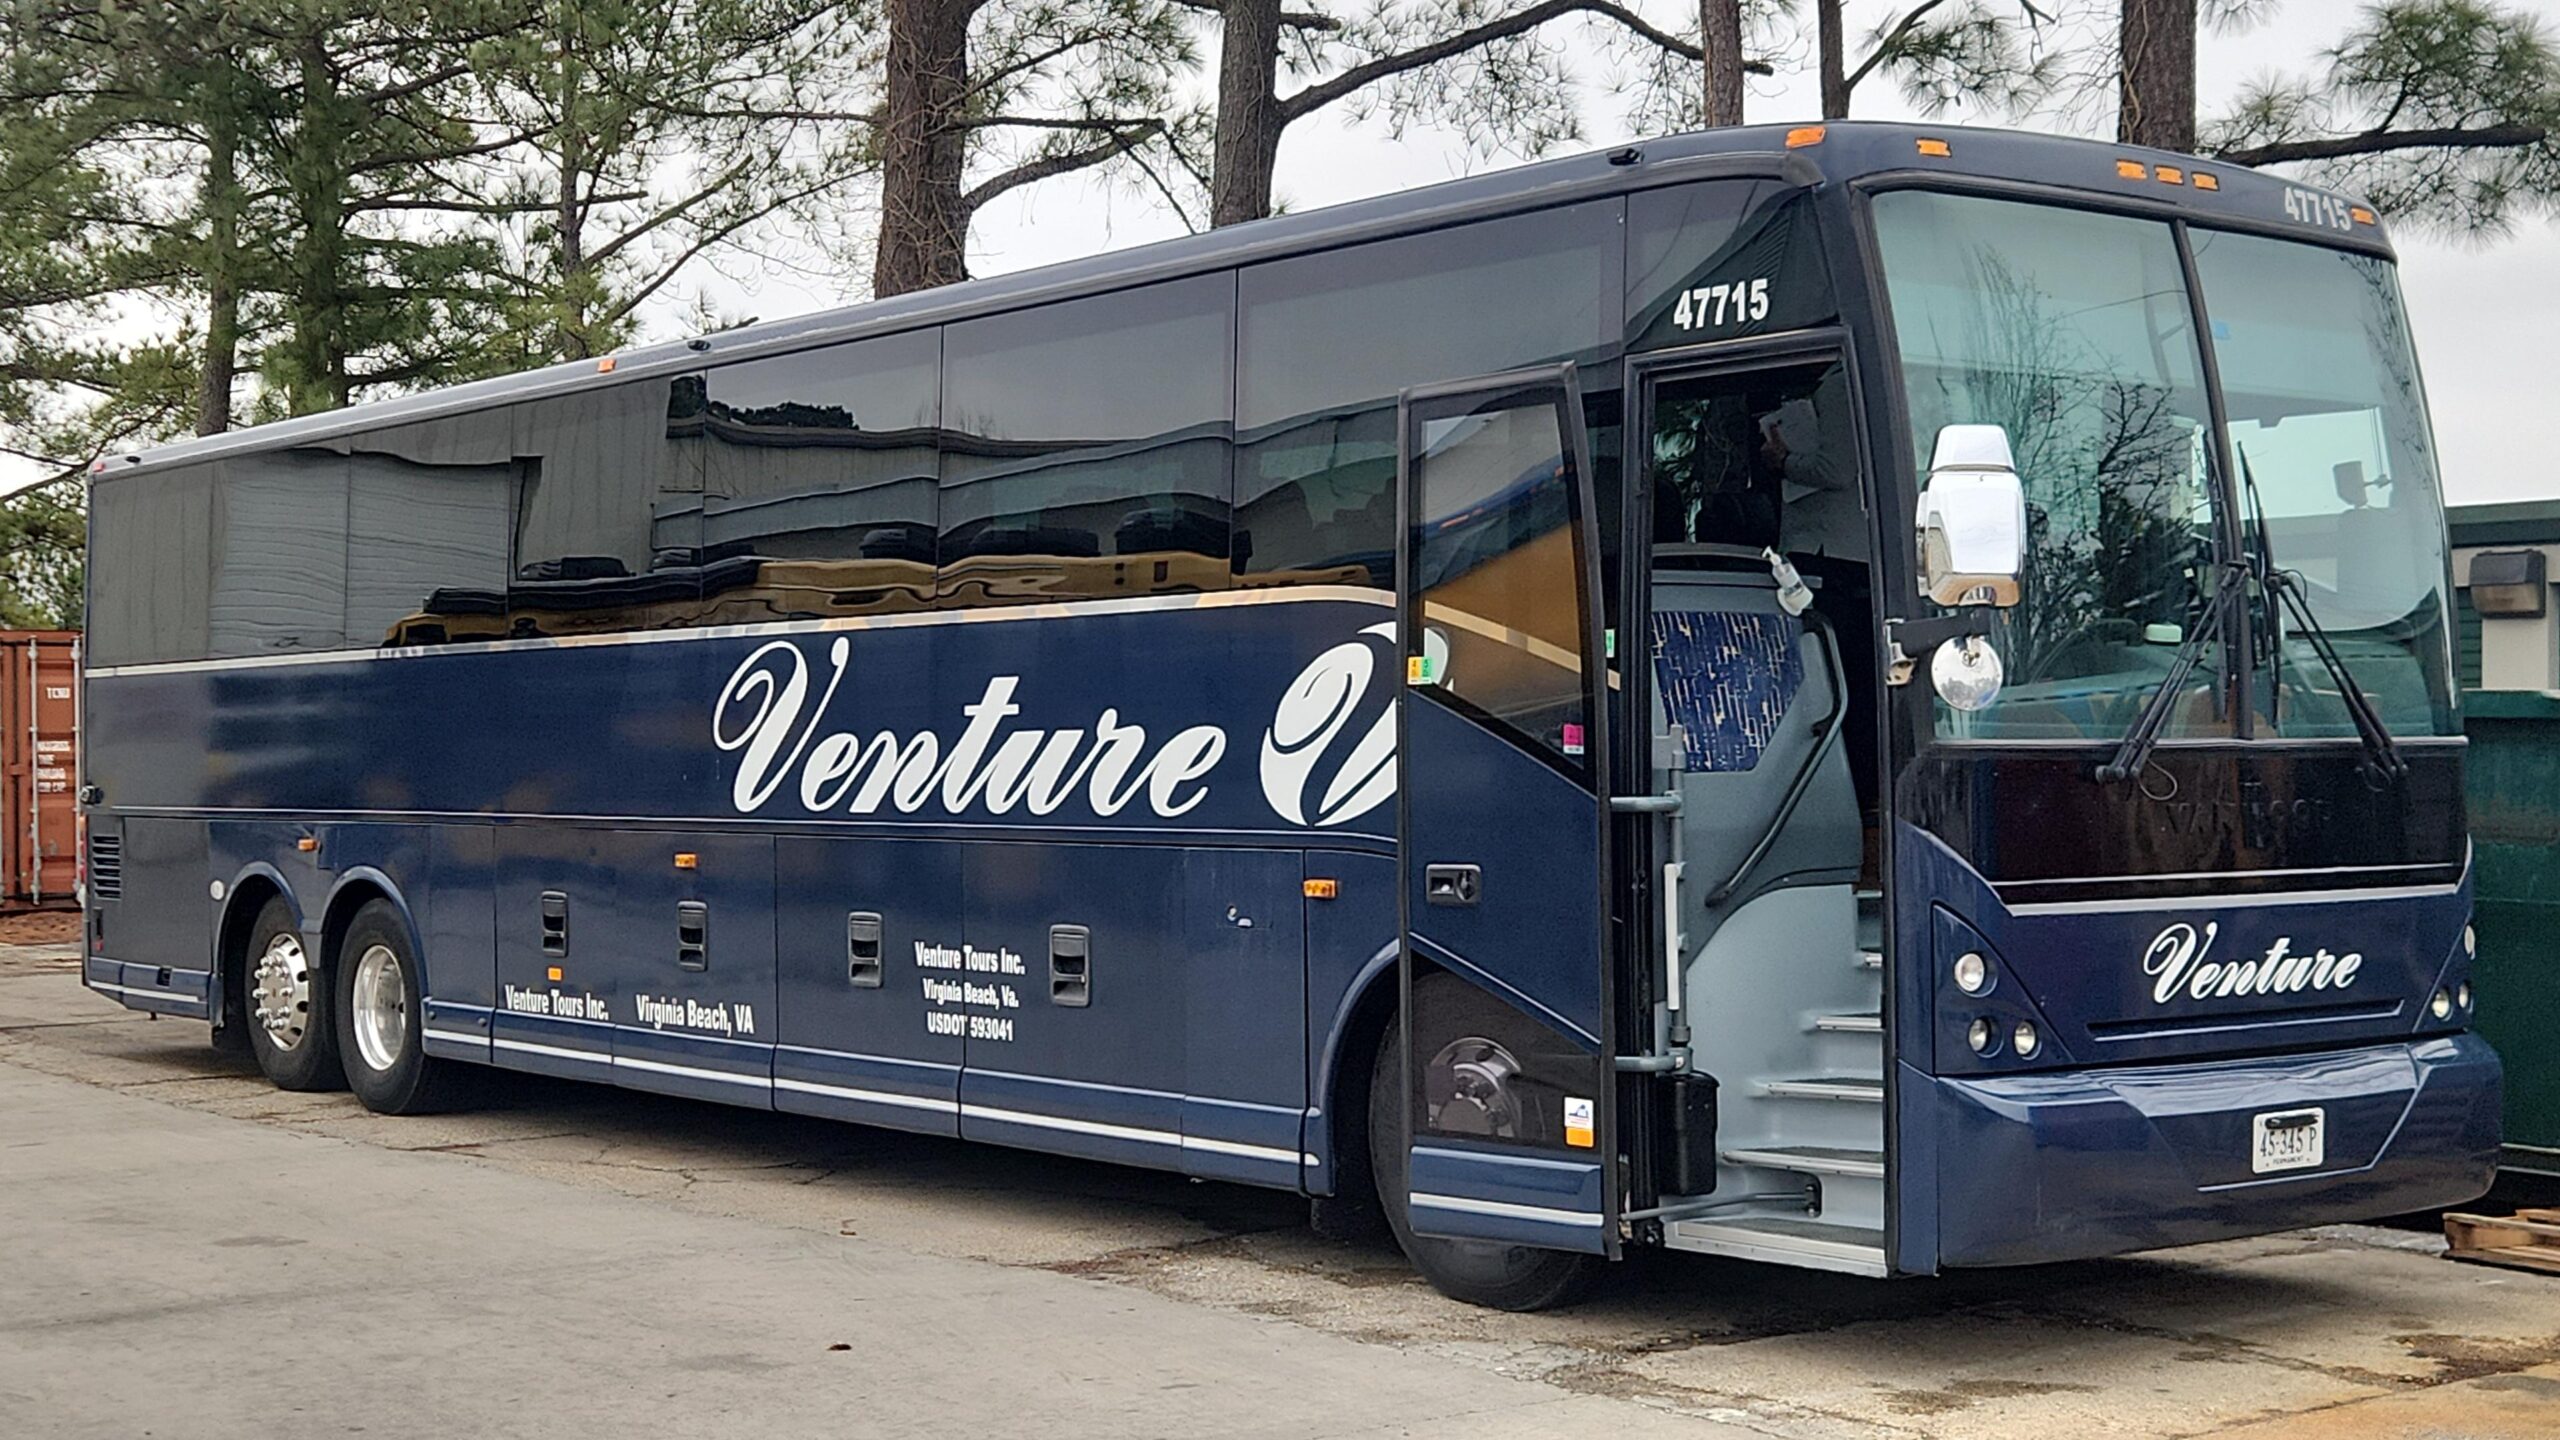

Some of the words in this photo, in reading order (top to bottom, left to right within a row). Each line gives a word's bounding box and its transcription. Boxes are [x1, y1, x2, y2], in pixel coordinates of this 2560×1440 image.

[2284, 186, 2352, 231] 47715
[1673, 278, 1769, 330] 47715
[712, 636, 1227, 818] Venture
[914, 941, 961, 969] Venture
[963, 944, 998, 972] Tours
[1001, 947, 1026, 975] Inc.
[2143, 922, 2362, 1004] Venture
[505, 985, 549, 1013] Venture
[551, 989, 584, 1017] Tours
[586, 992, 609, 1020] Inc.
[922, 978, 962, 1006] Virginia
[964, 982, 1000, 1010] Beach,
[1001, 985, 1020, 1008] Va.
[636, 994, 684, 1029] Virginia
[687, 999, 731, 1037] Beach,
[734, 1004, 754, 1034] VA
[927, 1011, 968, 1037] USDOT
[970, 1016, 1013, 1041] 593041
[2260, 1127, 2303, 1157] 45-345
